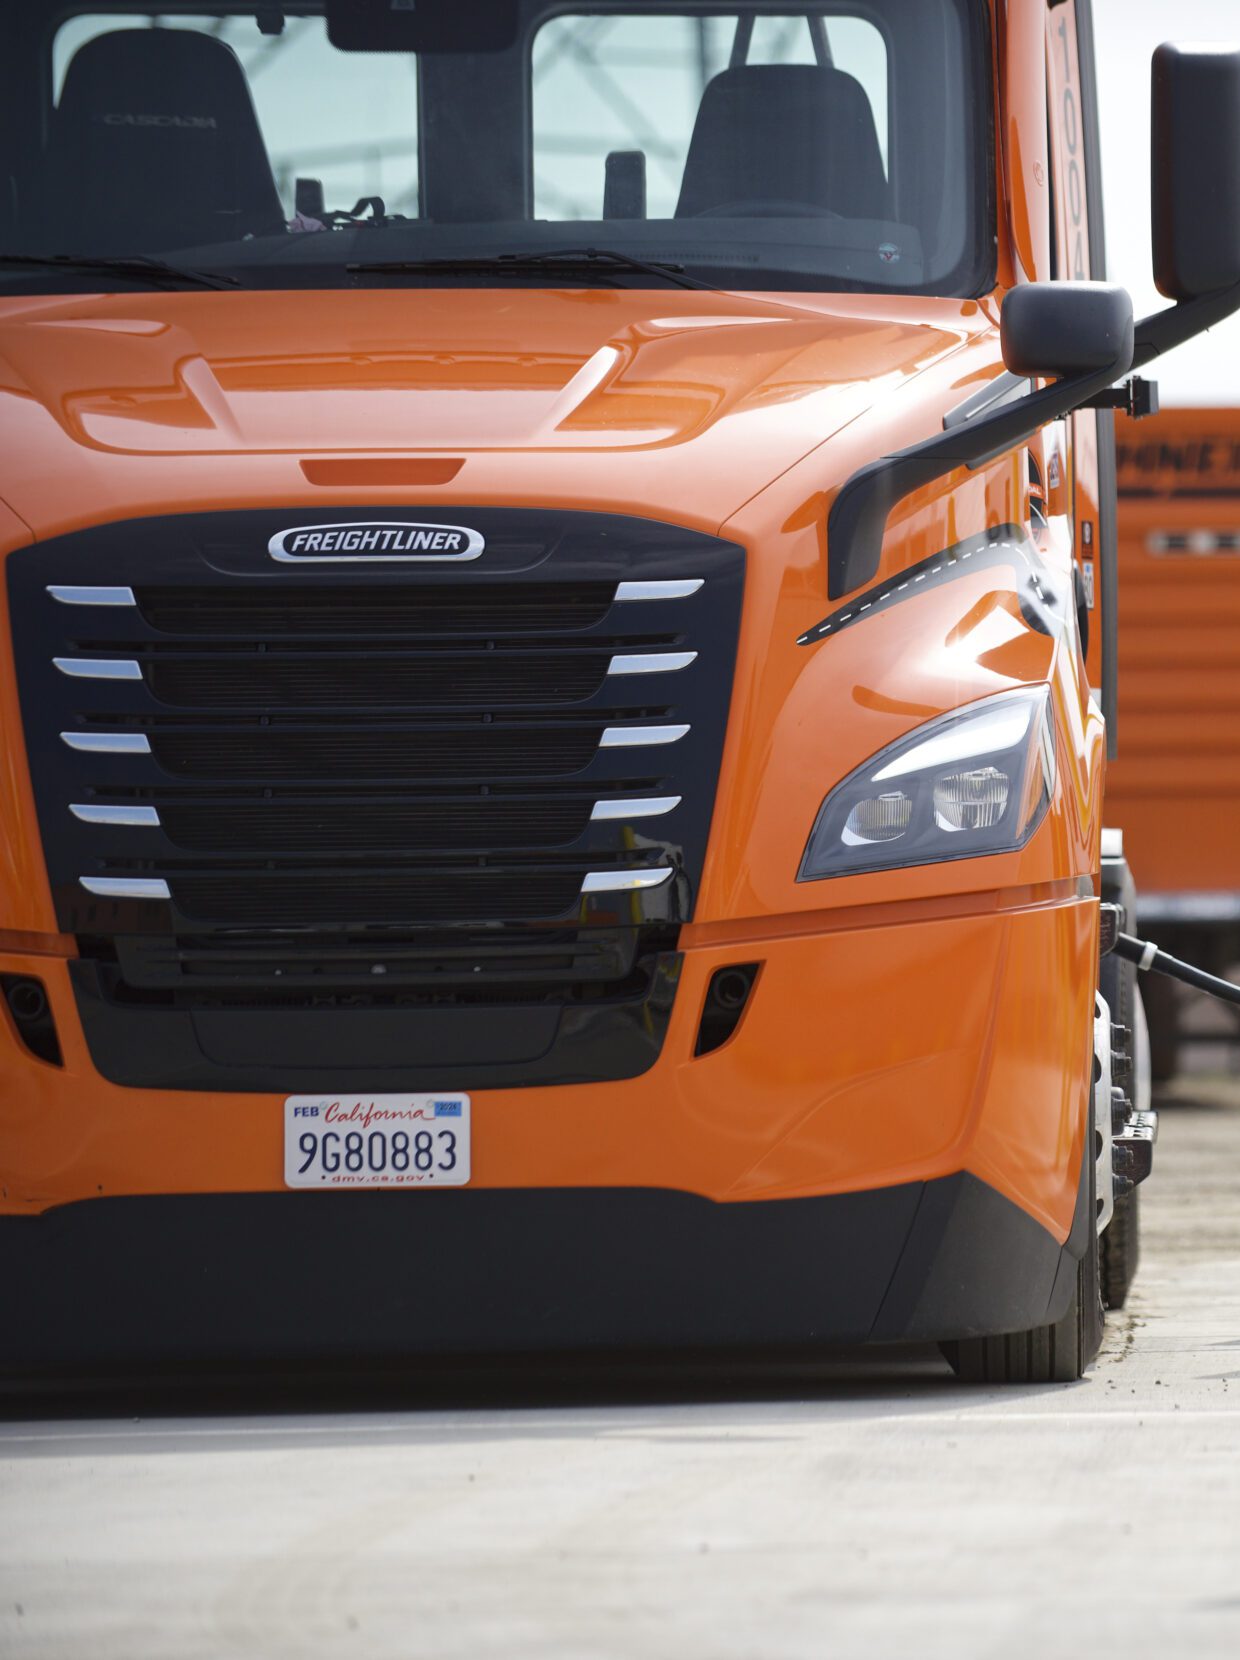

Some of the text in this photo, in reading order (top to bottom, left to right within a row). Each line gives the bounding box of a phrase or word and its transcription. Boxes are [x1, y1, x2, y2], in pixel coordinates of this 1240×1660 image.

[291, 530, 462, 551] FREIGHTLINER
[294, 1106, 319, 1117] FEB
[325, 1101, 435, 1129] California
[298, 1130, 456, 1174] 9G80883
[331, 1174, 424, 1184] dmv.ca.gov
